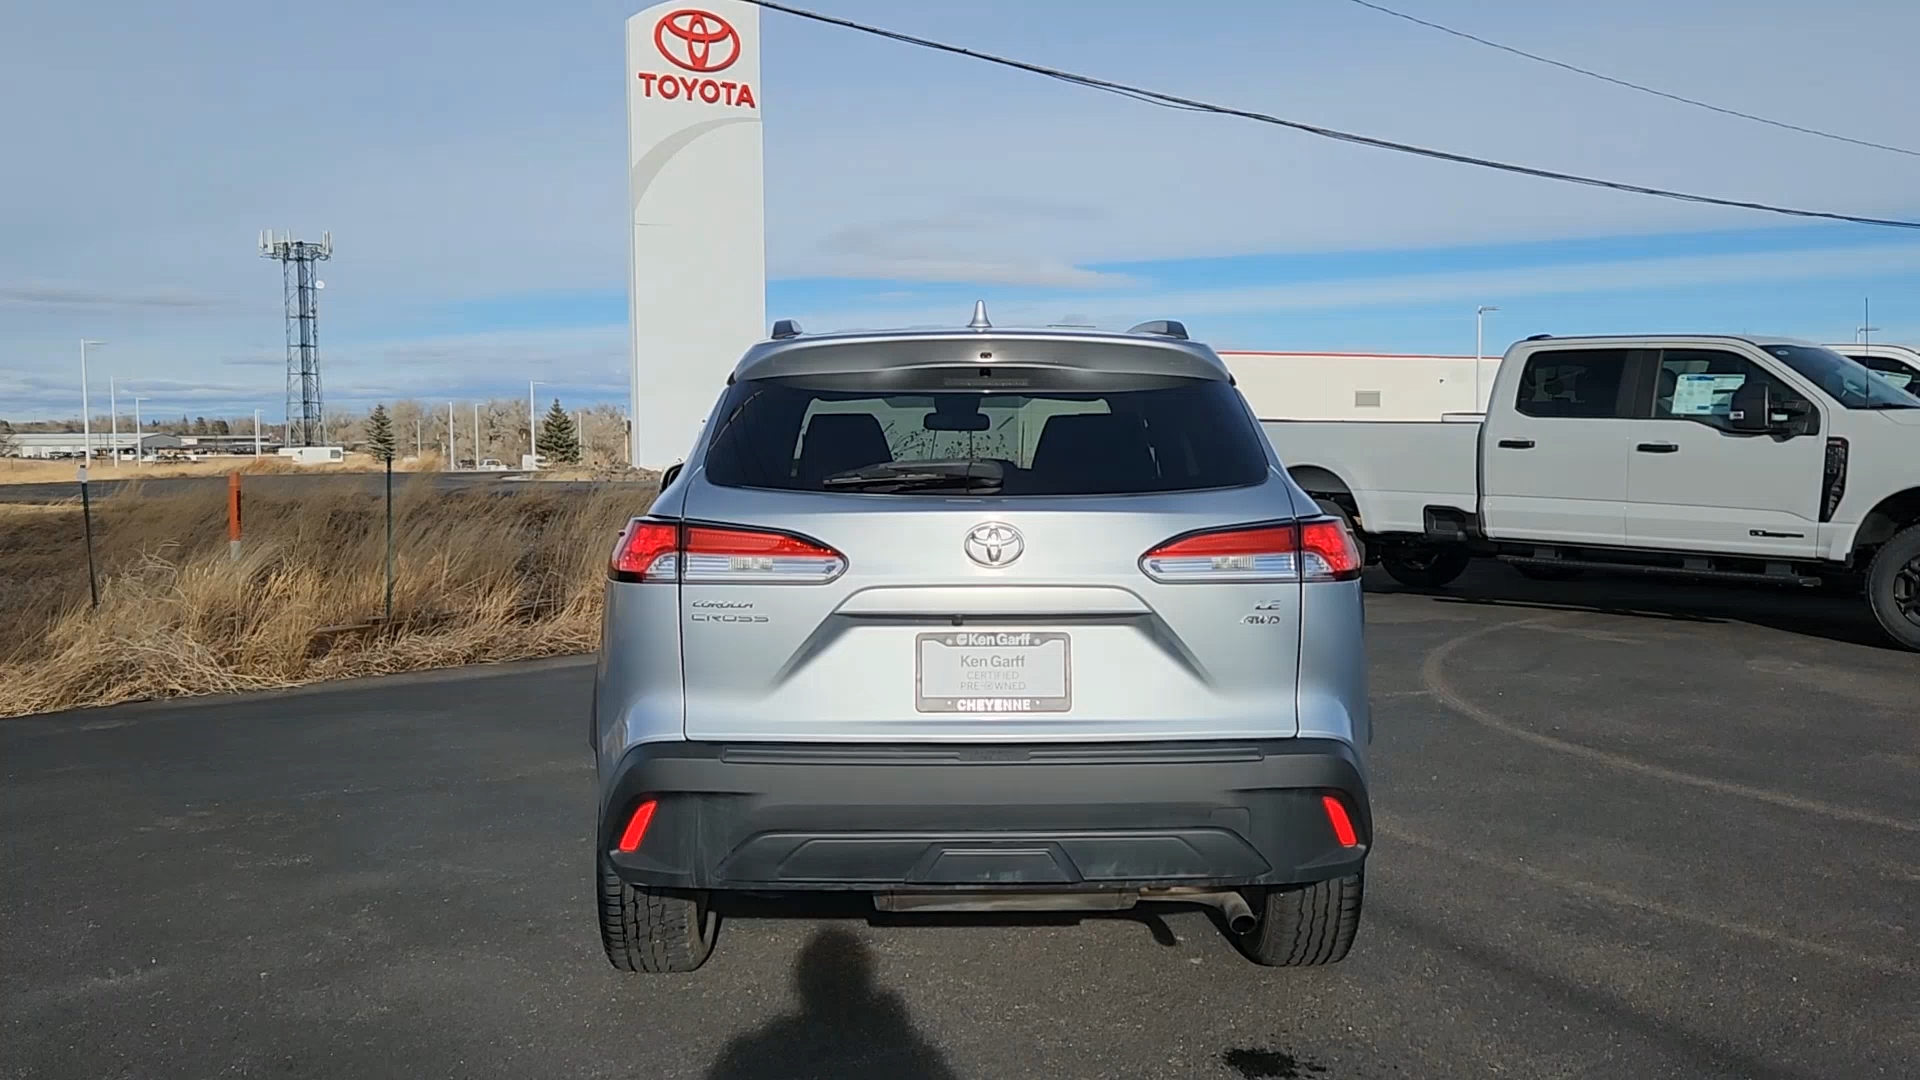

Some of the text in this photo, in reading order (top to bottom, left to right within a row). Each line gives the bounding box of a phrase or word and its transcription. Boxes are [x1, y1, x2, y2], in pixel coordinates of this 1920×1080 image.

[638, 72, 756, 109] TOYOTA
[1255, 599, 1281, 610] LE
[691, 613, 769, 623] CROSS
[1240, 615, 1280, 624] AWD
[968, 633, 1031, 646] Ken Garff
[960, 655, 1026, 668] Ken Garff
[966, 671, 1020, 680] CERTIFIED
[956, 698, 1032, 712] CHEYENNE
